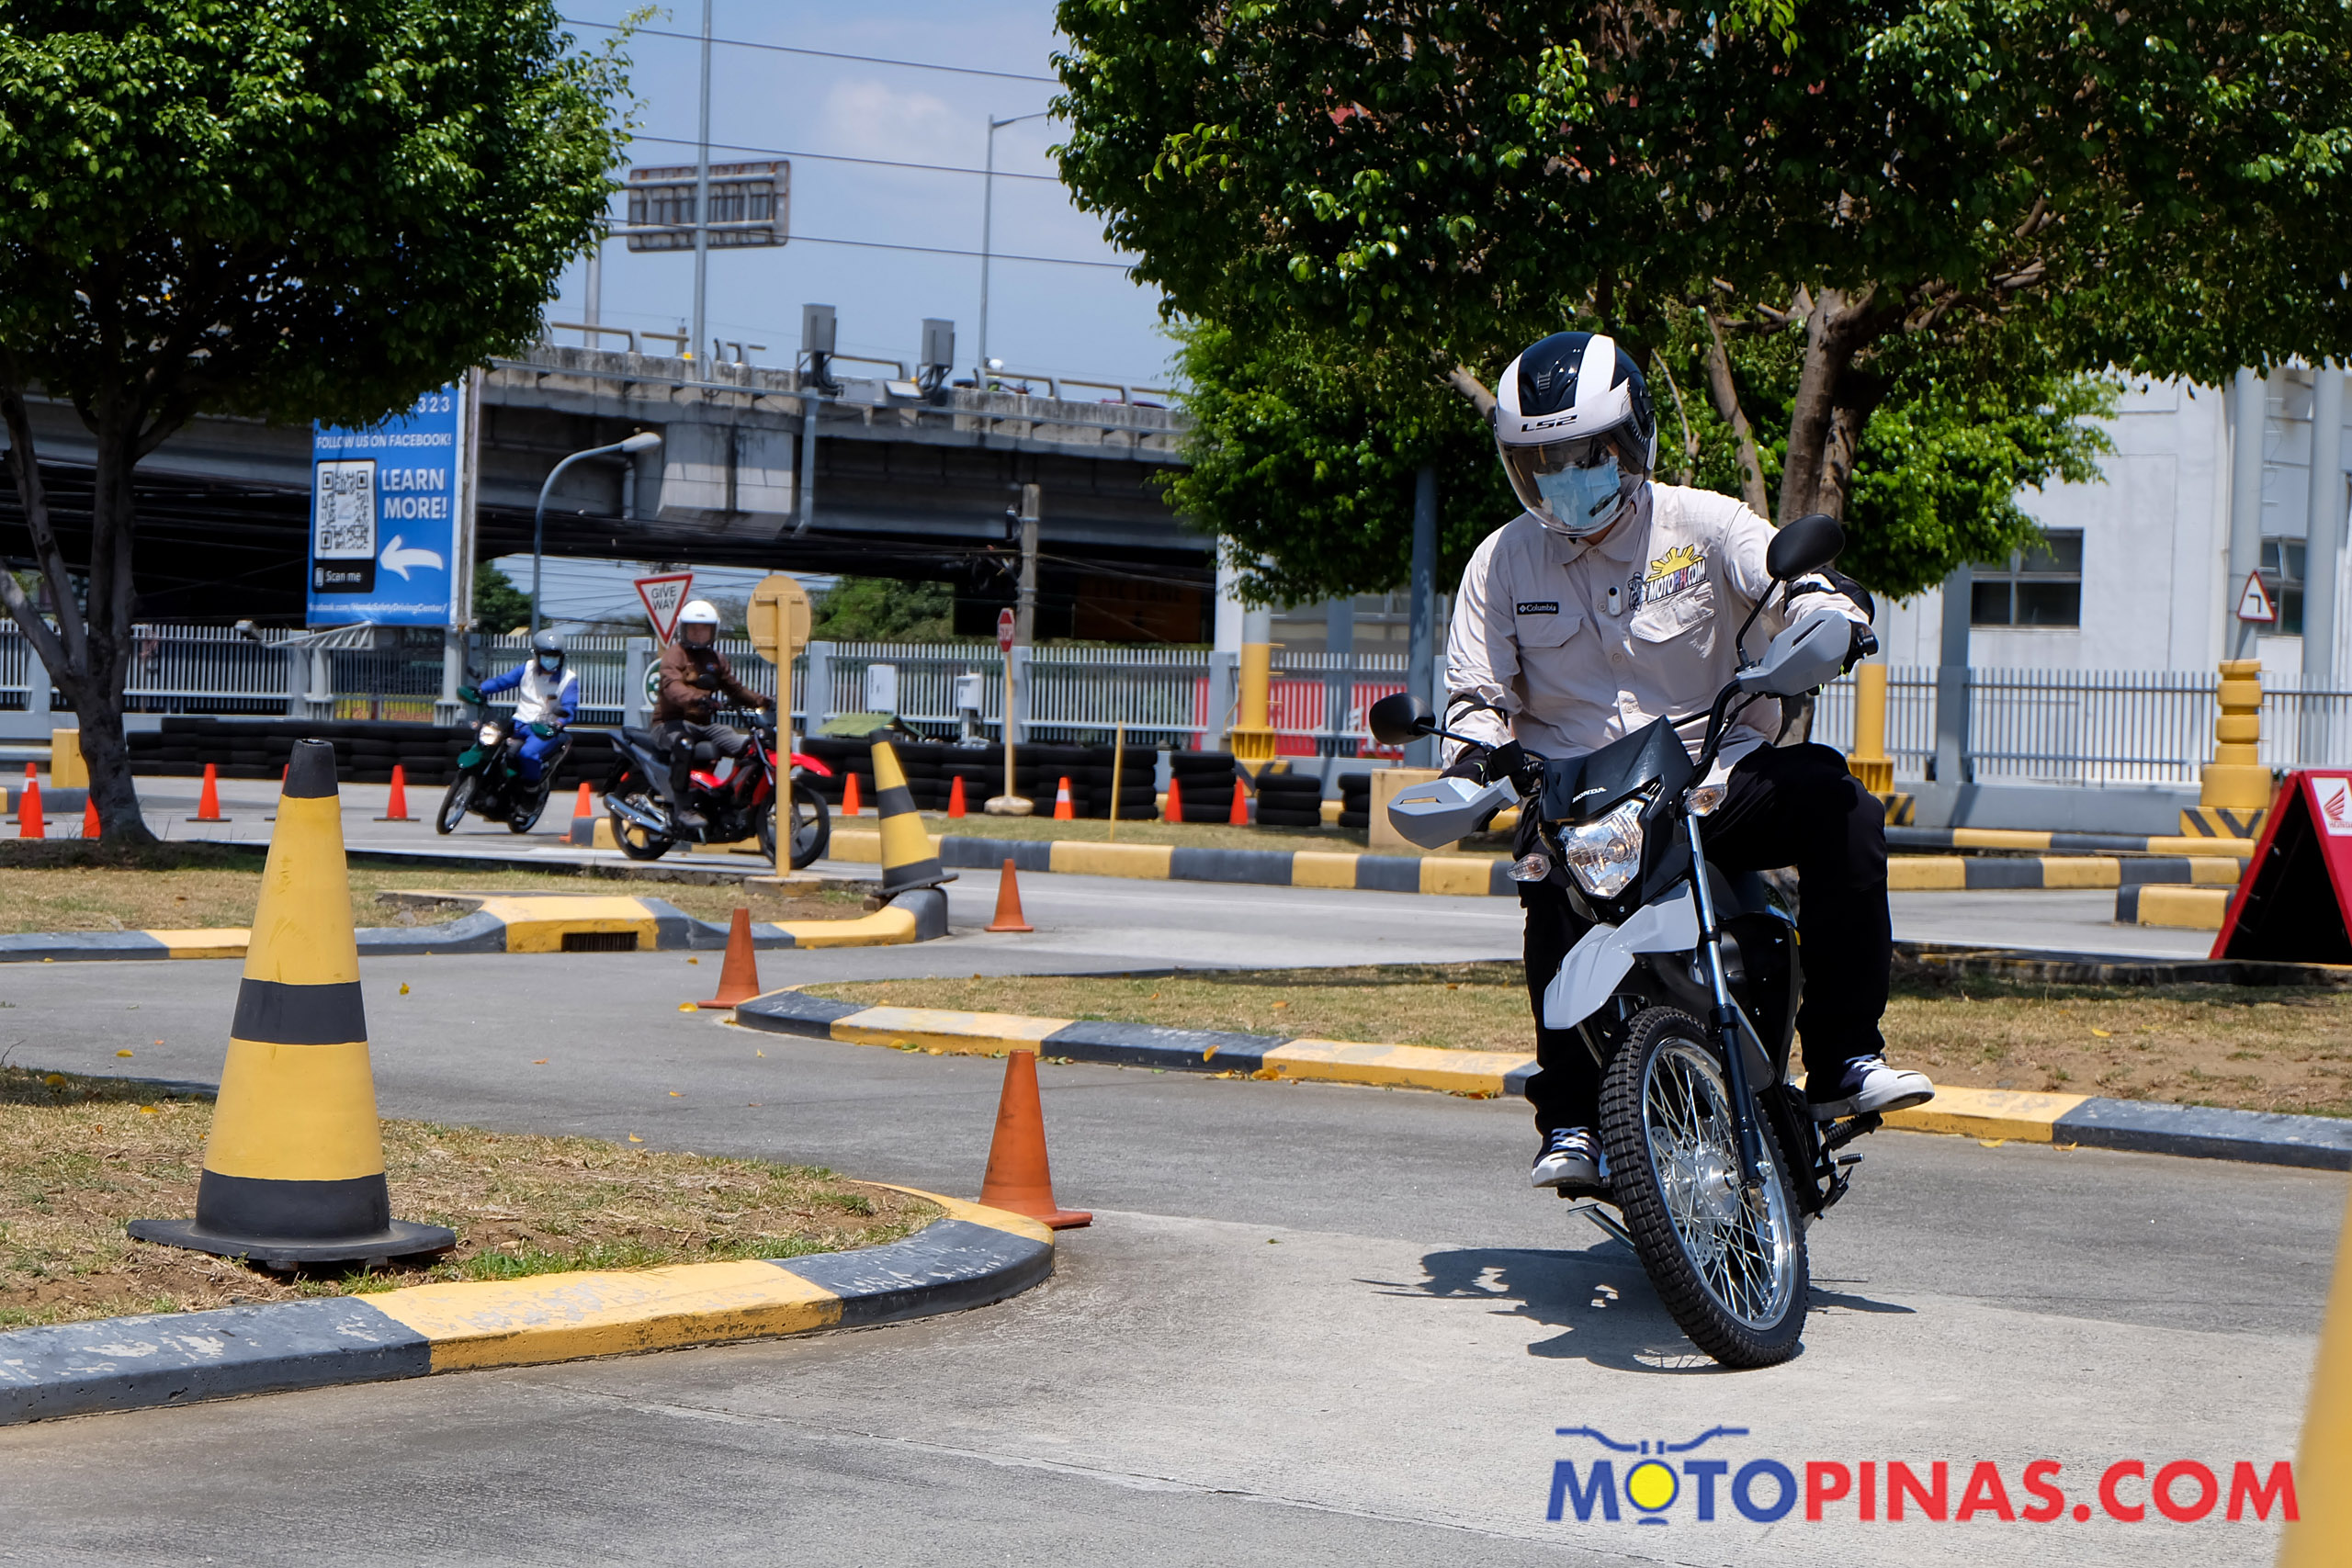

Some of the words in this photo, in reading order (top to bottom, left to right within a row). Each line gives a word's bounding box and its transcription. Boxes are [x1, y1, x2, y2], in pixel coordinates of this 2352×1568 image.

[1521, 414, 1577, 433] LS2
[315, 435, 355, 449] FOLLOW
[356, 435, 369, 448] US
[371, 434, 387, 447] ON
[389, 433, 452, 446] FACEBOOK!
[381, 468, 445, 491] LEARN
[383, 497, 447, 519] MORE!
[325, 570, 346, 582] Scan
[347, 572, 362, 581] me
[651, 585, 676, 598] GIVE
[653, 598, 675, 610] WAY
[1526, 604, 1556, 613] Columbia
[1572, 786, 1607, 803] HONDA
